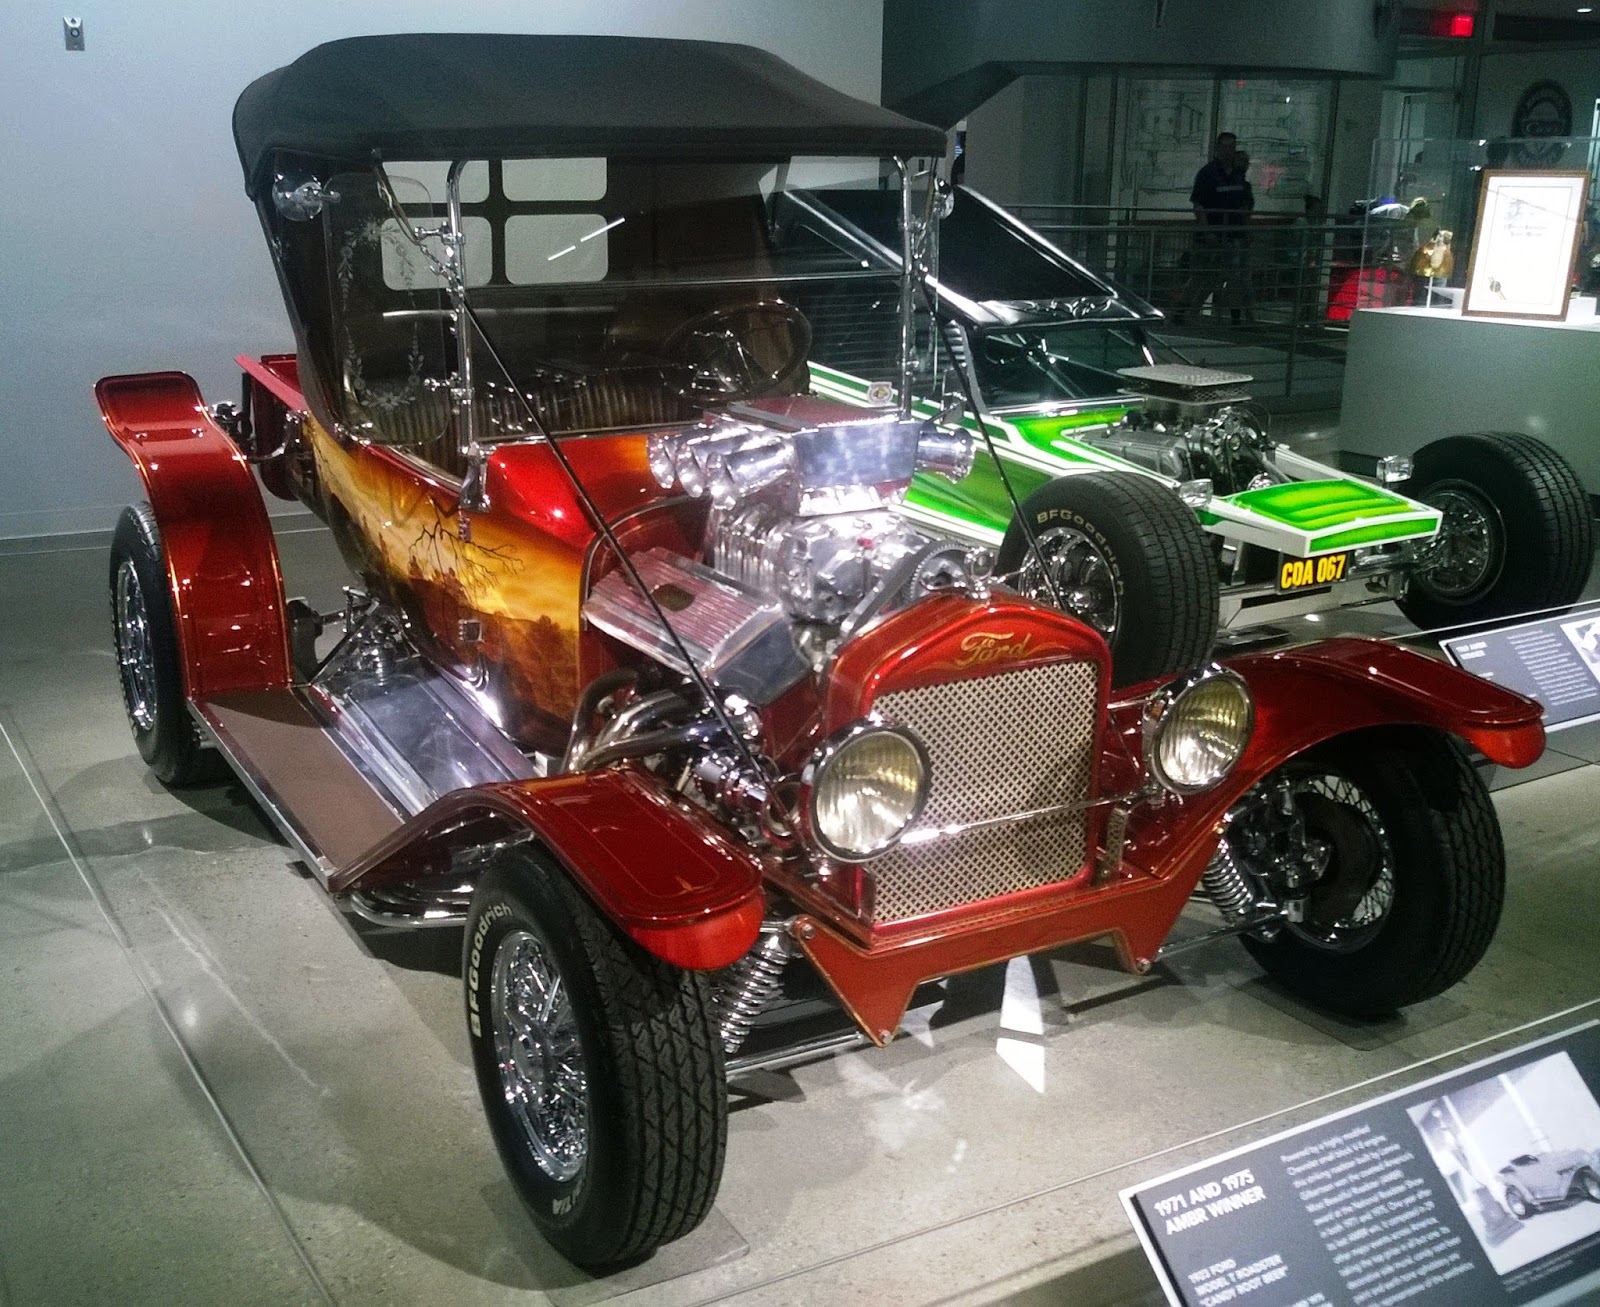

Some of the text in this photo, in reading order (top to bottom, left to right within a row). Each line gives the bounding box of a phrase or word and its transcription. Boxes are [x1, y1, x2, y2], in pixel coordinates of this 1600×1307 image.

[1036, 508, 1125, 596] BFGoodrich
[1316, 554, 1347, 583] 067
[955, 631, 1032, 667] Ford
[468, 901, 514, 1039] BFGoodrich
[1153, 1168, 1256, 1217] 1971 AND 1975
[1164, 1185, 1267, 1235] AMBR WINNER
[1208, 1258, 1237, 1276] FORD
